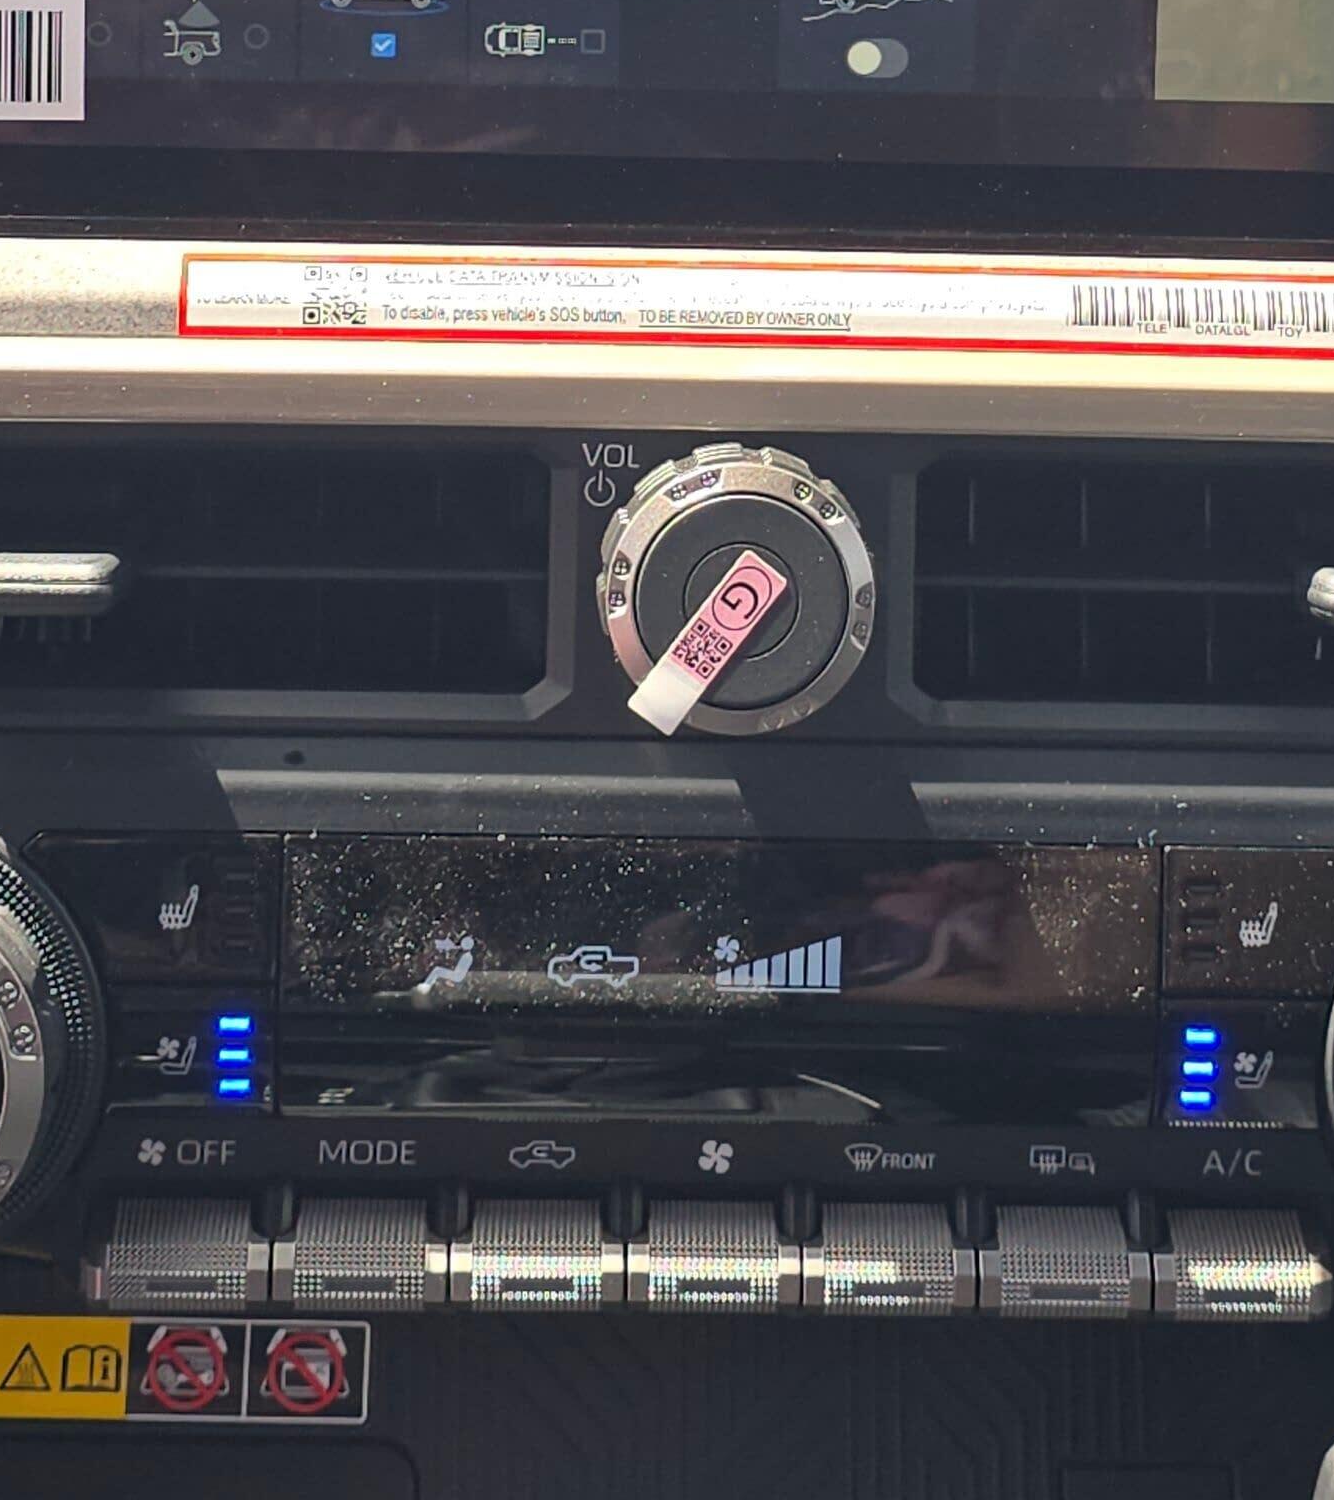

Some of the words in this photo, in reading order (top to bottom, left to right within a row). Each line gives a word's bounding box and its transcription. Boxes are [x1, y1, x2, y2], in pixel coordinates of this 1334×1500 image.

[382, 305, 397, 320] To
[400, 306, 449, 322] disable,
[453, 307, 488, 324] press
[492, 306, 545, 322] vehicle's
[550, 307, 579, 322] SOS
[583, 307, 627, 324] button.
[639, 309, 656, 323] TO
[659, 310, 676, 324] BE
[680, 310, 744, 325] REMOVED
[746, 311, 764, 325] BY
[767, 311, 815, 326] OWNER
[817, 312, 852, 327] ONLY
[1277, 326, 1304, 338] TOY
[581, 442, 640, 469] VOL
[177, 1139, 236, 1165] OFF
[319, 1139, 416, 1165] MODE
[882, 1152, 936, 1170] FRONT
[1202, 1149, 1263, 1176] A/C
